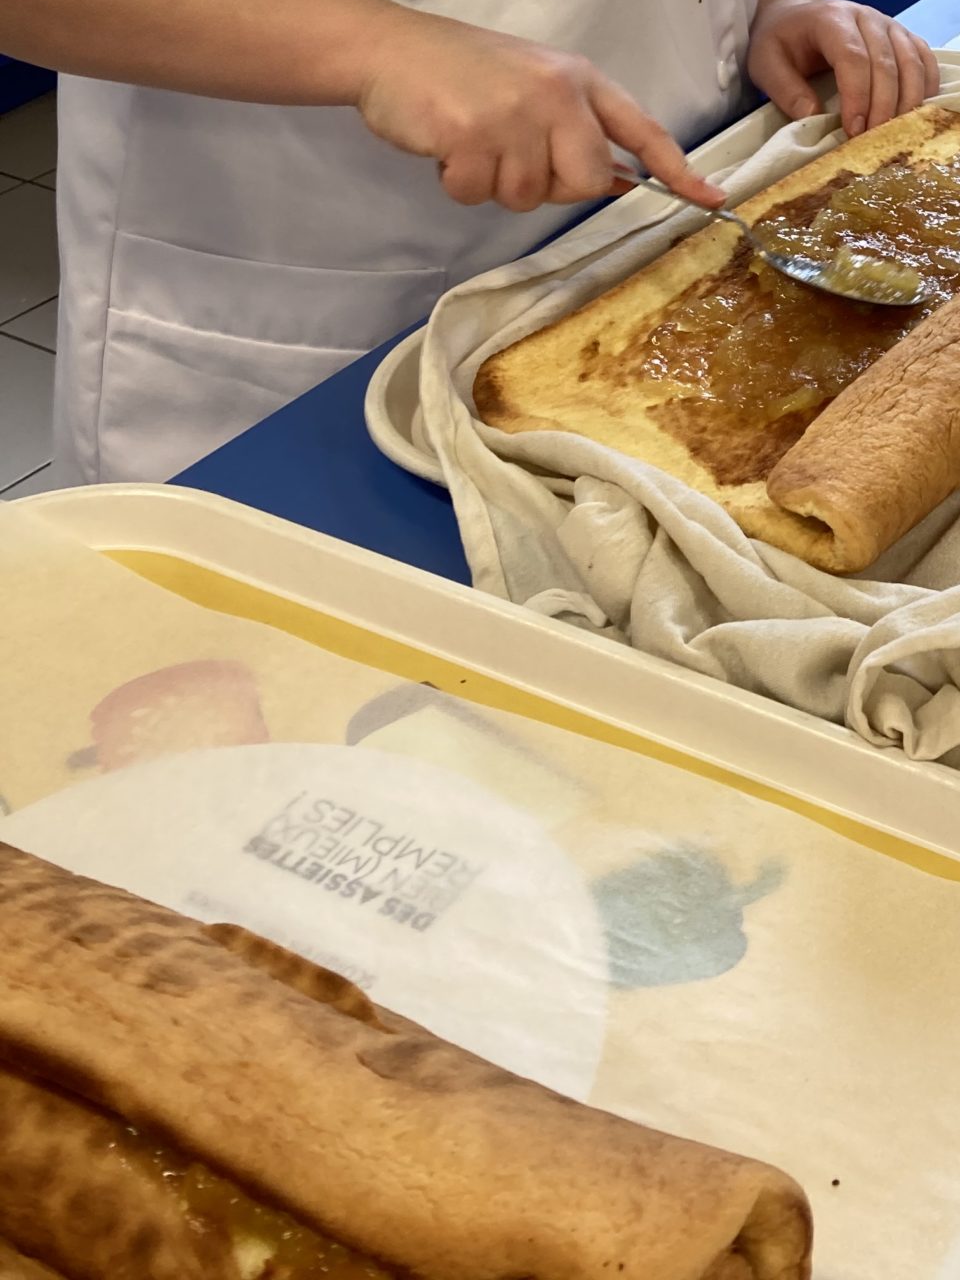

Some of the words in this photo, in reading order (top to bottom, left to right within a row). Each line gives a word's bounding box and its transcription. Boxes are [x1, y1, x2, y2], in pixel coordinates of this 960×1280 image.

[242, 834, 382, 905] ASSIETTES
[303, 798, 486, 882] REMPLIES
[378, 897, 437, 932] DES
